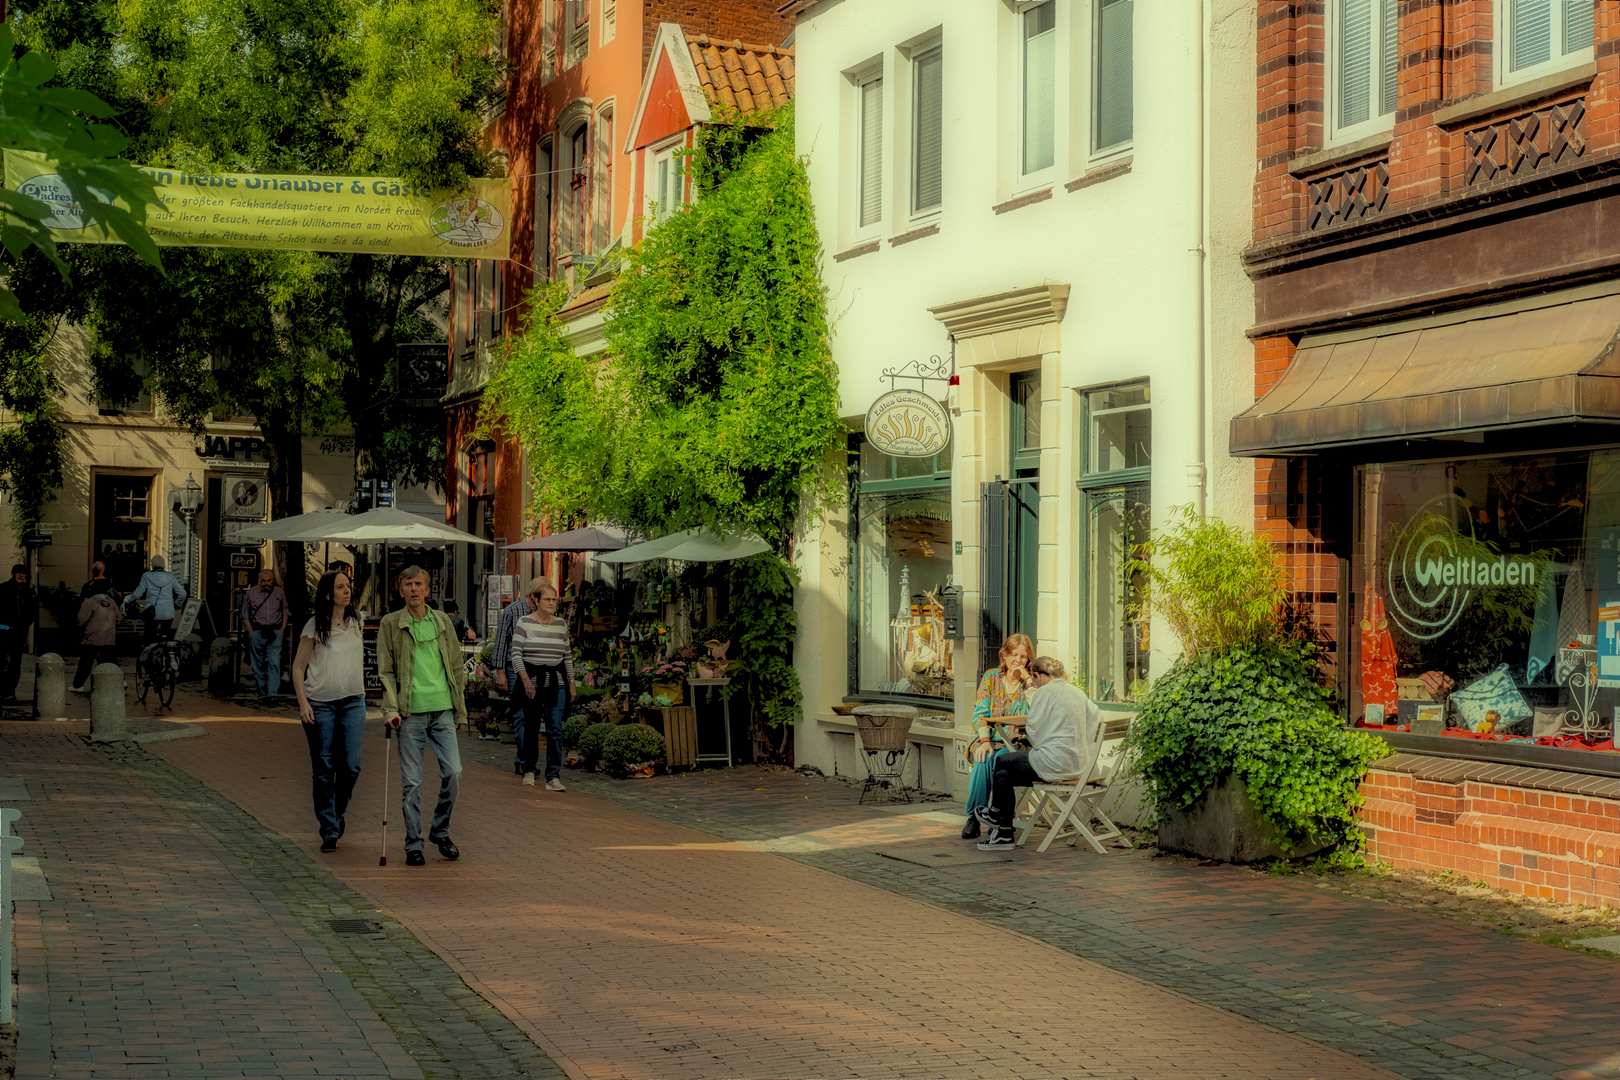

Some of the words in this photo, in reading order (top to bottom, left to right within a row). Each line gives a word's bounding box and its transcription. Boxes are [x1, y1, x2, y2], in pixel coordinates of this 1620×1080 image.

[244, 178, 344, 194] Urlauber
[350, 180, 366, 195] &
[160, 194, 177, 204] der
[182, 196, 224, 207] größten
[337, 203, 350, 213] im
[355, 204, 391, 215] Norden
[396, 205, 421, 216] freut
[155, 211, 176, 221] auf
[180, 211, 207, 222] Ihren
[212, 213, 250, 225] Besuch.
[256, 215, 298, 227] Herzlich
[302, 217, 362, 230] Willkommen
[366, 221, 381, 230] am
[386, 221, 413, 231] Krimi
[149, 226, 193, 239] Drehort
[198, 229, 217, 240] der
[221, 230, 270, 242] Altstadt.
[277, 232, 307, 244] Schön
[310, 234, 327, 245] das
[331, 234, 347, 245] Sie
[351, 235, 364, 246] da
[368, 237, 392, 247] sind!
[874, 400, 895, 416] Edles
[896, 395, 942, 423] Geschmeide
[234, 507, 256, 516] ZONE
[1415, 534, 1535, 586] Weltladen
